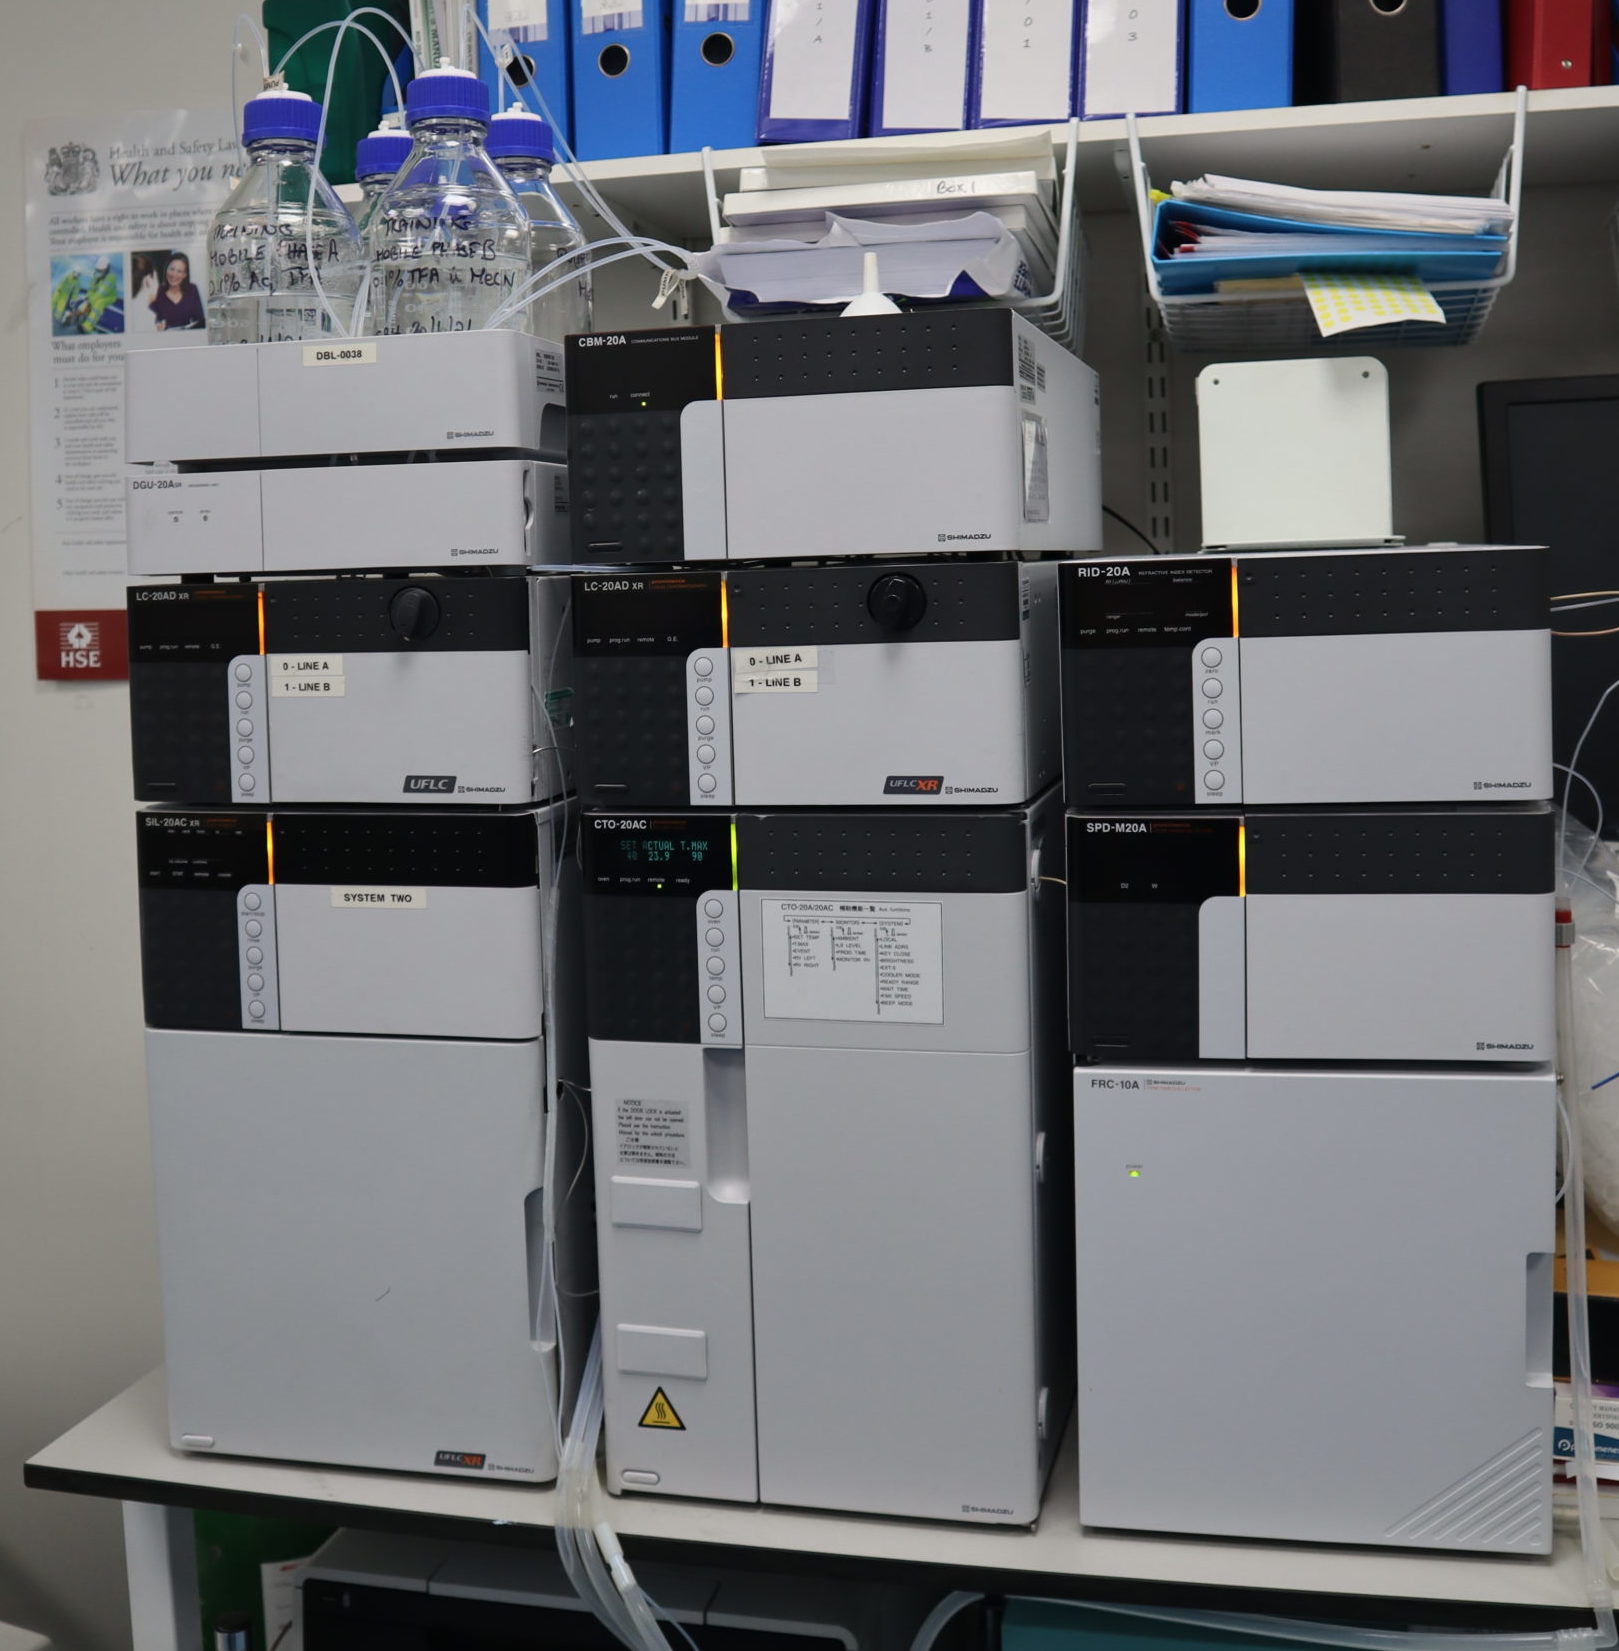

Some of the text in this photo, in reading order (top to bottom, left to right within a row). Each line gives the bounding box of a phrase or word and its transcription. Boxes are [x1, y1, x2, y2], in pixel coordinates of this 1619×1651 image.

[153, 145, 175, 156] and
[180, 139, 213, 156] Safety
[111, 161, 170, 186] What
[176, 167, 212, 189] you
[937, 180, 966, 194] Box
[328, 238, 340, 262] A
[482, 238, 497, 261] B
[408, 267, 440, 285] TFA
[579, 336, 627, 347] CBM-20A
[316, 350, 362, 361] DBL-0038
[1078, 567, 1131, 578] RID-20A
[584, 581, 629, 591] LC-20AD
[136, 592, 176, 601] LC-20AD
[61, 650, 101, 668] HSE
[766, 655, 792, 665] LINE
[794, 653, 803, 663] A
[297, 662, 320, 670] LINE
[322, 661, 329, 670] A
[285, 683, 289, 691] 1
[298, 683, 320, 691] LINE
[324, 682, 331, 691] B
[749, 679, 755, 687] 1
[766, 677, 790, 687] LINE
[794, 678, 802, 687] B
[410, 779, 449, 790] UFLC
[146, 818, 187, 827] SIL-20AC
[189, 820, 200, 828] XR
[594, 820, 647, 830] CTO-20AC
[1086, 822, 1147, 833] SPD-M20A
[620, 840, 708, 850] SET ACTUAL T.MAX
[648, 851, 670, 861] 23.9
[344, 893, 413, 903] SYSTEM TWO
[1091, 1079, 1139, 1090] FRC-10A
[496, 1465, 535, 1473] SHIMADZU
[971, 1506, 1014, 1515] SHIMADZU
